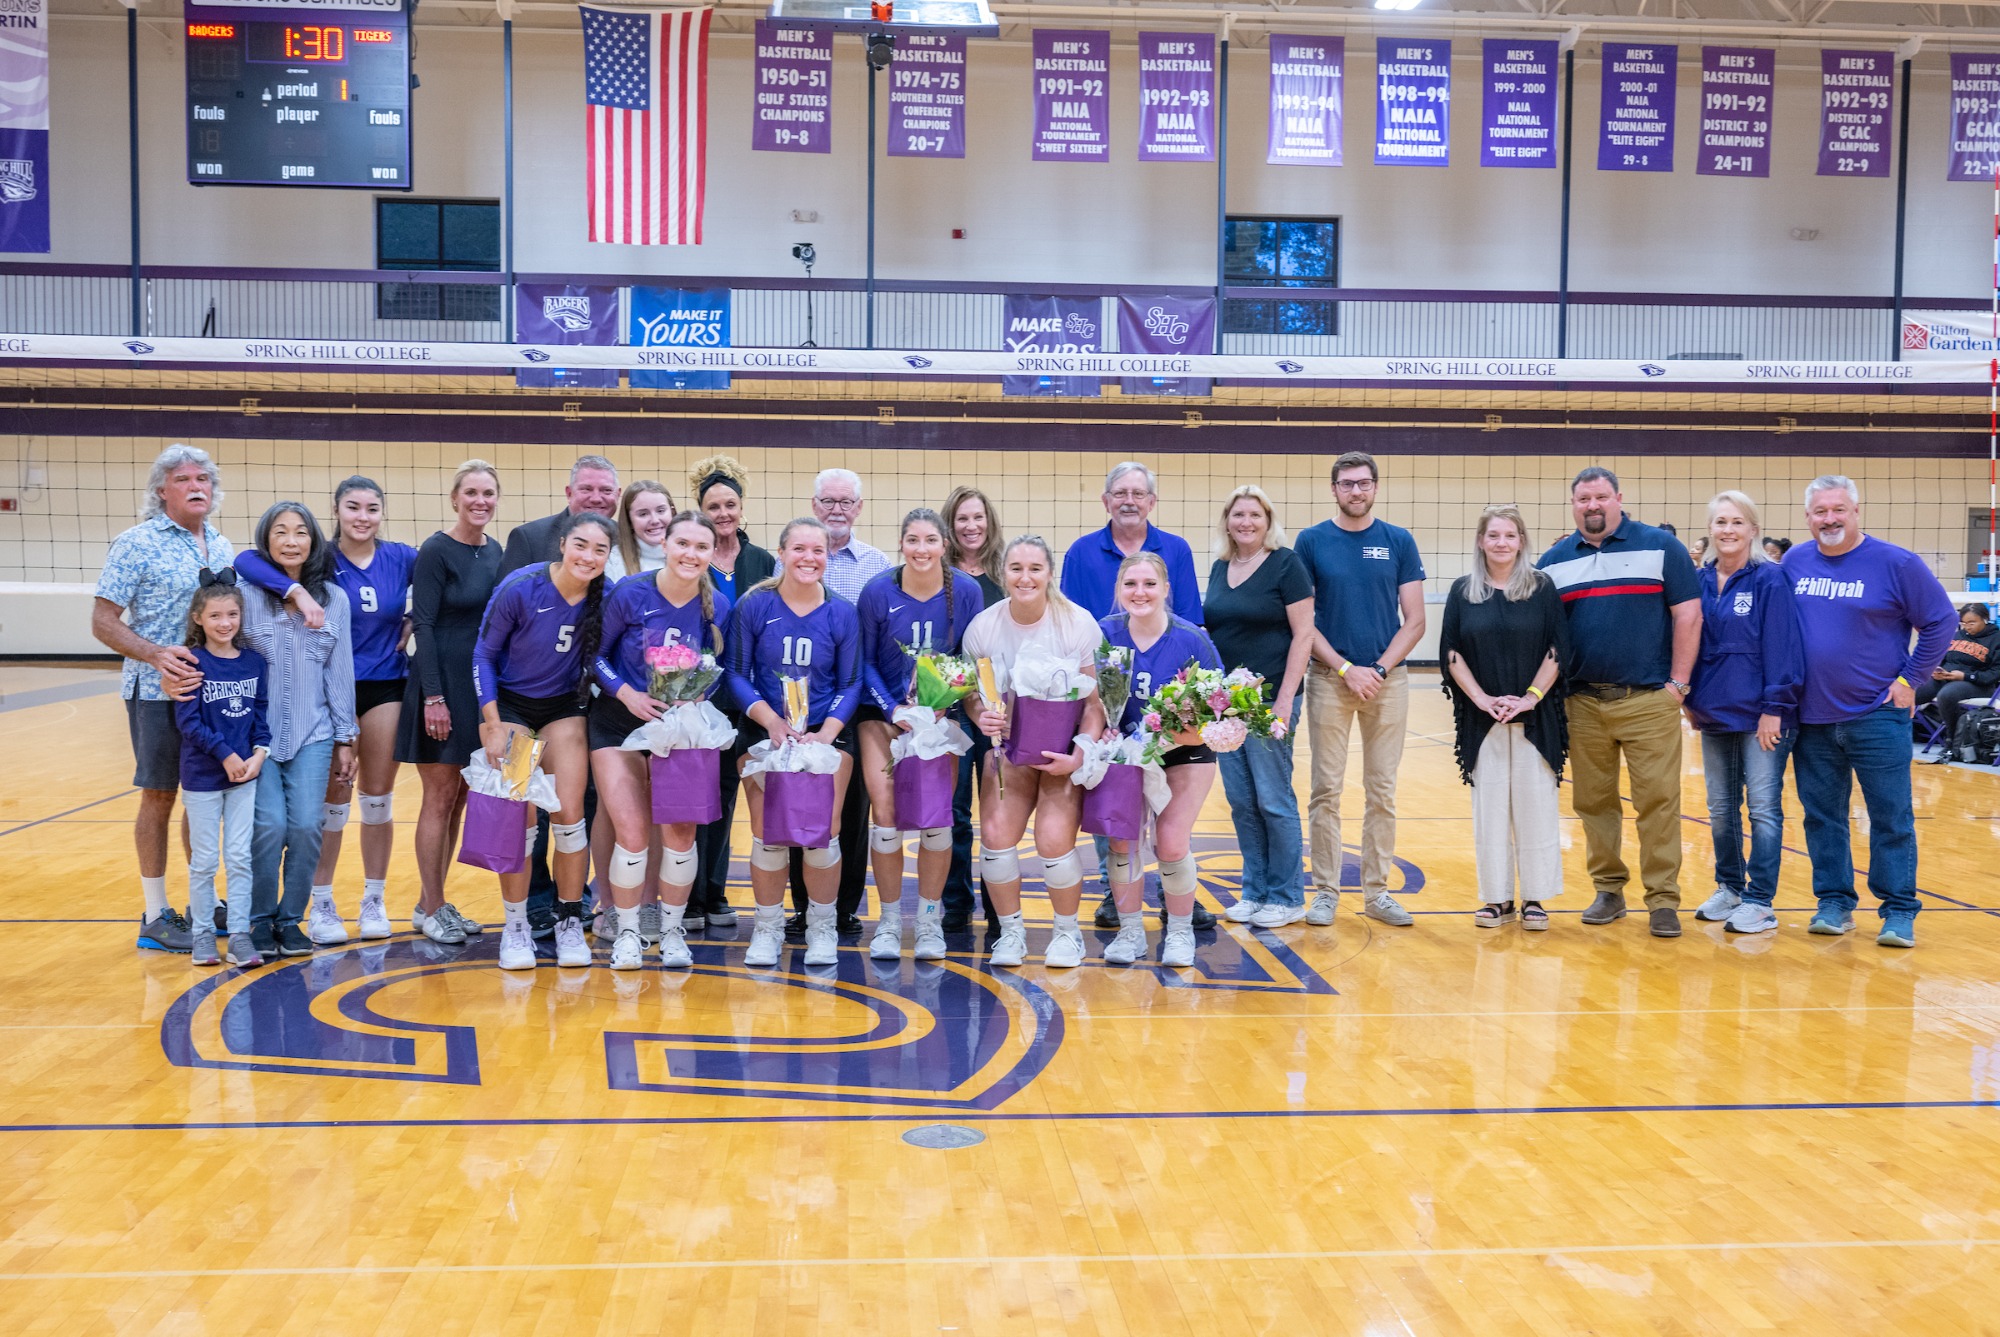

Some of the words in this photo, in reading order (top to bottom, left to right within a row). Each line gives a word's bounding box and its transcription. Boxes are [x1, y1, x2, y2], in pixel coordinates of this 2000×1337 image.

[189, 25, 234, 37] BADGERS
[354, 30, 392, 42] TIGERS
[777, 29, 815, 43] MEN'S
[285, 27, 343, 60] 1:30
[909, 35, 947, 46] MEN'S
[758, 46, 831, 61] BASKETBALL
[1052, 42, 1090, 55] MEN'S
[1158, 42, 1195, 55] MEN'S
[1289, 47, 1325, 60] MEN'S
[1396, 48, 1432, 61] MEN'S
[1507, 50, 1534, 61] MEN'S
[1626, 49, 1653, 61] MEN'S
[892, 49, 964, 64] BASKETBALL
[1720, 55, 1755, 68] MEN'S
[1035, 58, 1107, 72] BASKETBALL
[1141, 59, 1212, 72] BASKETBALL
[1272, 63, 1341, 77] BASKETBALL
[1379, 63, 1448, 77] BASKETBALL
[1494, 63, 1546, 74] BASKETBALL
[1613, 62, 1665, 74] BASKETBALL
[1840, 58, 1875, 70] MEN'S
[761, 68, 827, 87] 1950-51
[895, 70, 960, 89] 1974-75
[1703, 71, 1770, 85] BASKETBALL
[1824, 74, 1891, 87] BASKETBALL
[277, 83, 318, 99] period
[1040, 78, 1103, 97] 1991-92
[1952, 79, 2000, 91] BASKETB
[758, 92, 784, 105] GULF
[789, 94, 828, 107] STATES
[891, 91, 933, 104] SOUTHERN
[936, 93, 964, 105] STATES
[1143, 89, 1210, 107] 1992-93
[1380, 85, 1447, 102] 1998-99
[1825, 91, 1888, 109] 1992-93
[1278, 94, 1334, 111] 1993-94
[1508, 102, 1531, 112] NAIA
[1626, 96, 1649, 106] NAIA
[1706, 93, 1766, 112] 1991-92
[1955, 97, 2000, 114] 1993-
[194, 105, 225, 120] fouls
[277, 106, 319, 124] player
[760, 108, 825, 123] CHAMPIONS
[903, 105, 952, 117] CONFERENCE
[1052, 101, 1090, 119] NAIA
[1391, 108, 1437, 124] NAIA
[1616, 108, 1659, 119] NATIONAL
[370, 110, 400, 125] fouls
[1157, 113, 1195, 130] NAIA
[1498, 115, 1541, 126] NATIONAL
[1828, 113, 1867, 123] DISTRICT
[1870, 114, 1882, 124] 30
[903, 119, 950, 131] CHAMPIONS
[1050, 122, 1092, 131] NATIONAL
[1287, 117, 1323, 134] NAIA
[1607, 121, 1667, 133] TOURNAMENT
[1704, 119, 1749, 132] DISTRICT
[1753, 121, 1767, 132] 30
[775, 129, 809, 146] 19-8
[1042, 131, 1101, 141] TOURNAMENT
[1155, 133, 1197, 143] NATIONAL
[1384, 128, 1441, 142] NATIONAL
[1489, 127, 1549, 139] TOURNAMENT
[1839, 126, 1871, 140] GCAC
[908, 135, 945, 152] 20-7
[1285, 137, 1326, 147] NATIONAL
[1705, 134, 1765, 148] CHAMPIONS
[1829, 142, 1880, 153] CHAMPIONS
[1146, 144, 1205, 154] TOURNAMENT
[1276, 147, 1334, 158] TOURNAMENT
[1377, 143, 1447, 157] TOURNAMENT
[197, 163, 222, 175] won
[1714, 155, 1752, 172] 24-11
[1837, 158, 1869, 172] 22-9
[282, 165, 315, 179] game
[372, 167, 397, 179] won
[545, 298, 588, 315] BADGERS
[669, 310, 708, 321] MAKE
[709, 310, 723, 321] IT
[638, 313, 722, 347] YOURS
[1010, 318, 1062, 332] MAKE
[1065, 313, 1096, 338] SHC
[1145, 306, 1189, 344] SHC
[1931, 325, 1969, 335] Hilton
[1930, 336, 1992, 350] Garden
[245, 344, 306, 358] SPRING
[311, 346, 350, 359] HILL
[355, 346, 431, 360] COLLEGE
[637, 351, 696, 365] SPRING
[702, 353, 739, 366] HILL
[743, 353, 817, 367] COLLEGE
[1017, 358, 1074, 371] SPRING
[1080, 359, 1116, 372] HILL
[1120, 359, 1192, 372] COLLEGE
[1386, 362, 1441, 375] SPRING
[1447, 362, 1482, 375] HILL
[1486, 363, 1556, 376] COLLEGE
[1746, 365, 1800, 378] SPRING
[1806, 366, 1840, 378] HILL
[1845, 366, 1913, 379] COLLEGE
[1794, 577, 1865, 600] #hillyeah
[359, 586, 378, 613] 9
[555, 625, 576, 652] 5
[911, 621, 932, 648] 11
[782, 636, 812, 667] 10
[202, 680, 240, 703] SPRING
